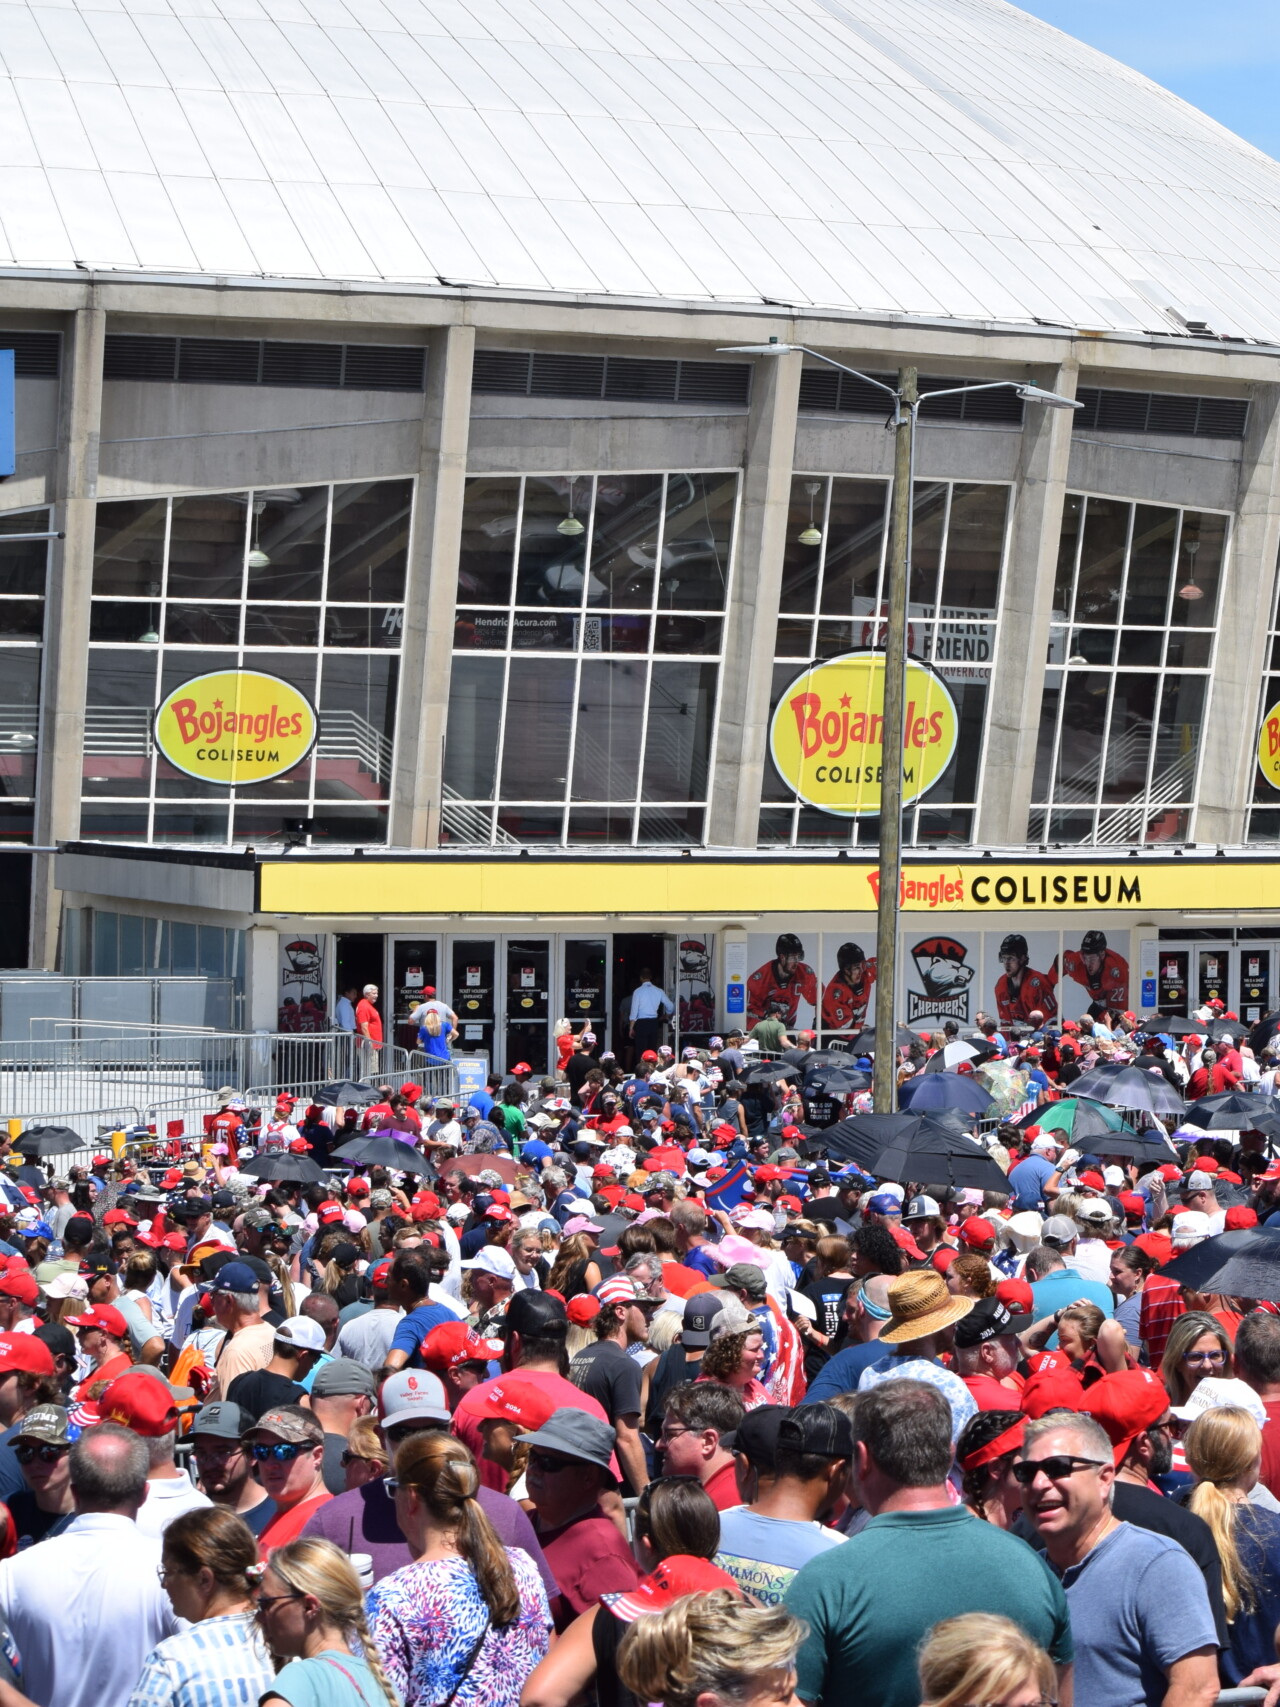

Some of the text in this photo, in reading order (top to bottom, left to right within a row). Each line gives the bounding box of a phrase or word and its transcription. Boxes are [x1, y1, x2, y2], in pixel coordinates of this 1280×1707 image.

[474, 616, 557, 627] HendricAcura.com
[922, 636, 990, 662] FRIEND
[170, 698, 303, 745] Bojangles
[790, 691, 944, 759] Bojanles
[196, 749, 280, 762] COLISEUM
[815, 765, 914, 784] COLISEM
[971, 875, 1142, 904] COLISEUM
[1110, 989, 1126, 1002] 22
[836, 1009, 844, 1020] 9
[569, 1356, 596, 1365] REEDOM
[505, 1402, 522, 1414] 2024
[721, 1563, 785, 1590] IMMONS
